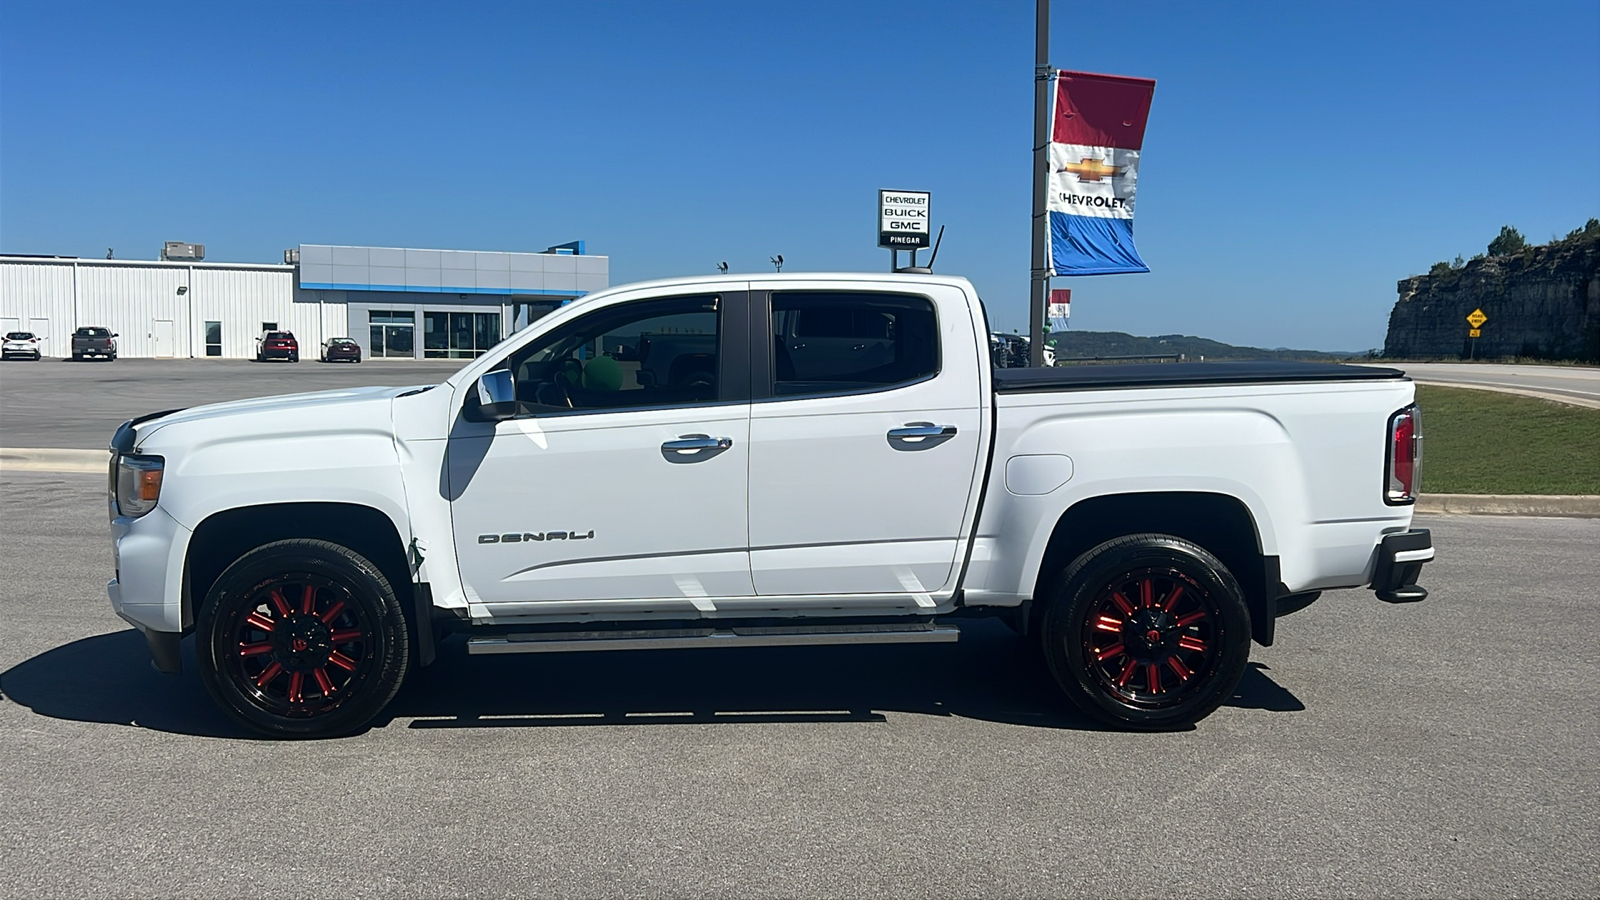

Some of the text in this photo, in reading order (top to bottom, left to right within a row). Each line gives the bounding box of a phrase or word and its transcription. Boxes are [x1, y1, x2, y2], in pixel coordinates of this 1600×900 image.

[885, 196, 926, 205] CHEVROLET
[884, 208, 926, 218] BUICK
[890, 221, 921, 230] GMC
[890, 236, 920, 244] PINEGAR
[478, 530, 594, 544] DENALI
